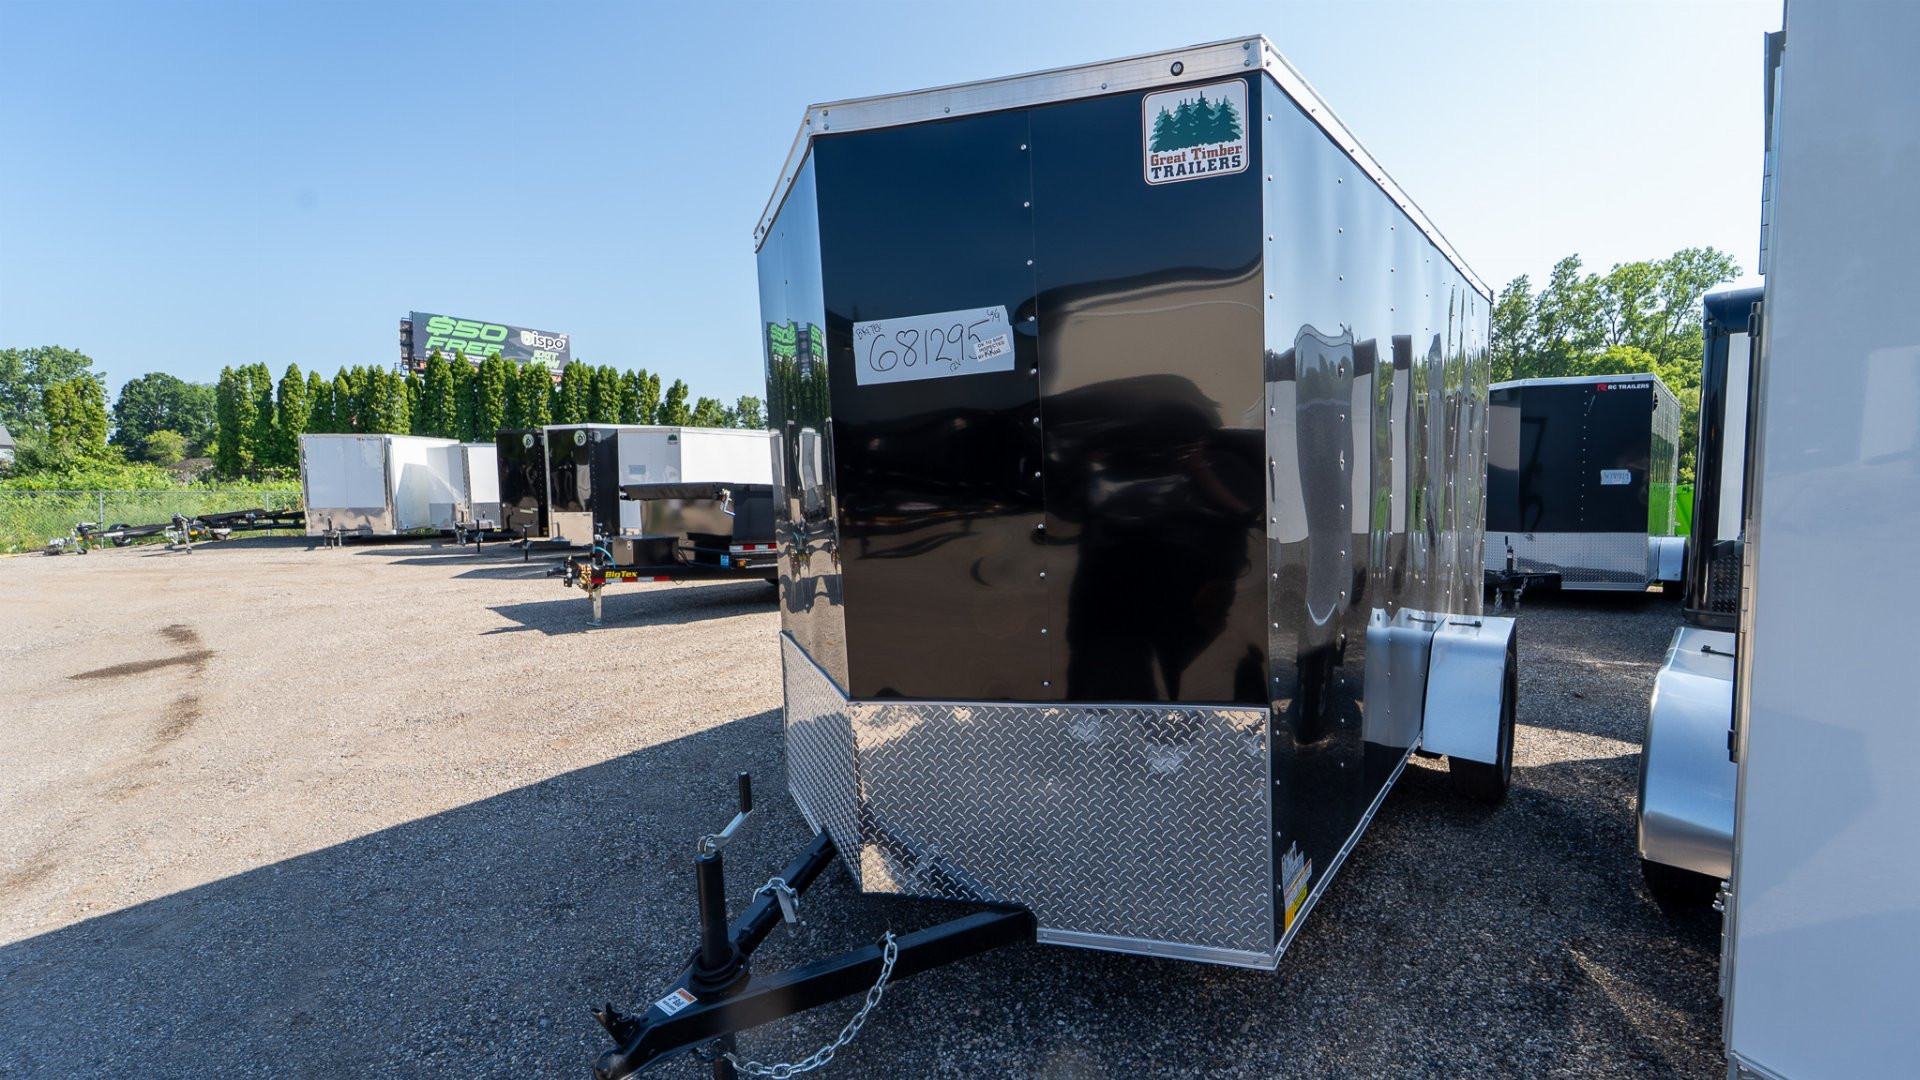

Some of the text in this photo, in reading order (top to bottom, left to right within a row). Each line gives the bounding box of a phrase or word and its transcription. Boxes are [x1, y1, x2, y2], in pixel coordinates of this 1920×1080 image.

[1150, 144, 1243, 167] Great Timber
[1151, 155, 1242, 180] TRAILERS
[425, 315, 509, 342] $50
[425, 336, 506, 357] FREE
[1618, 383, 1650, 391] TRAILERS
